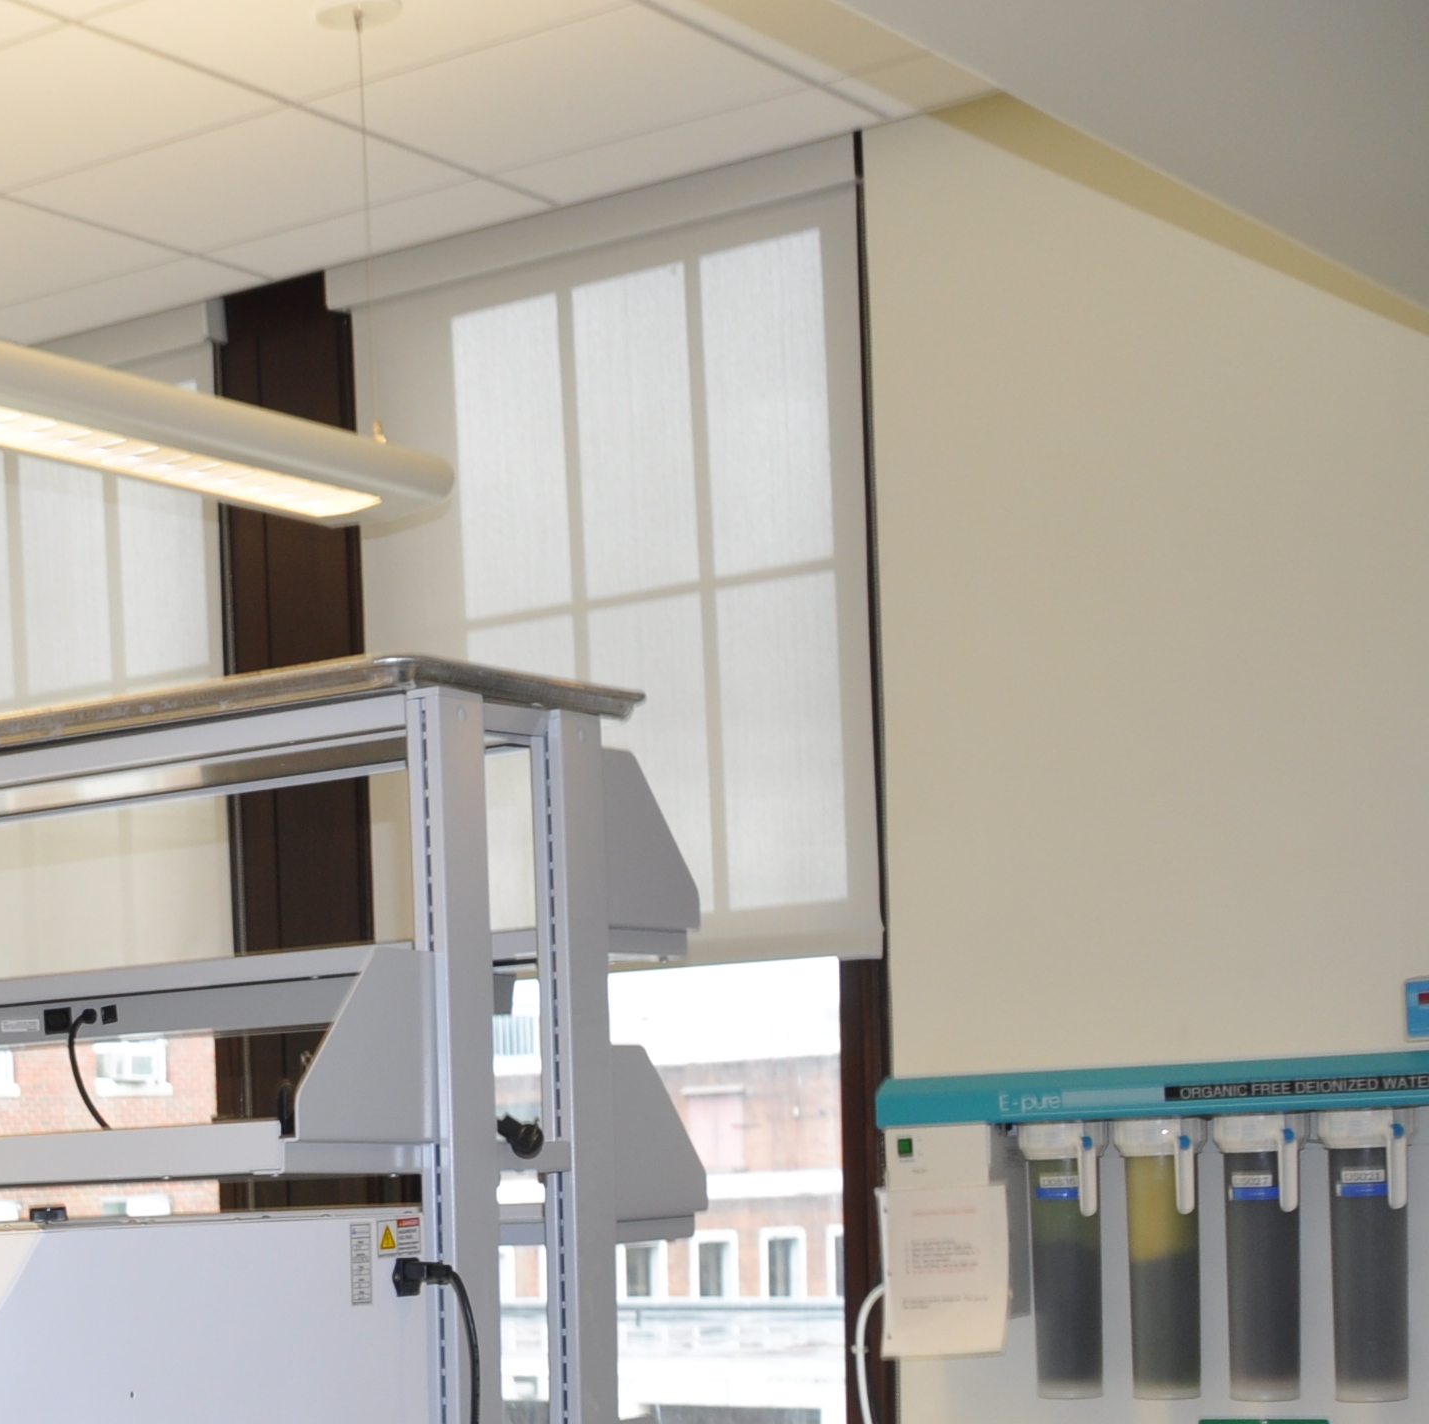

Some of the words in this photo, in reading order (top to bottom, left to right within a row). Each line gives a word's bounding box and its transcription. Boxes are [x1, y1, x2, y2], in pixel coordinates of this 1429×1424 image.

[1180, 1084, 1248, 1099] ORGANIC
[1251, 1082, 1290, 1095] FREE
[1295, 1078, 1379, 1094] DEIONIZED
[1382, 1075, 1429, 1090] WATE
